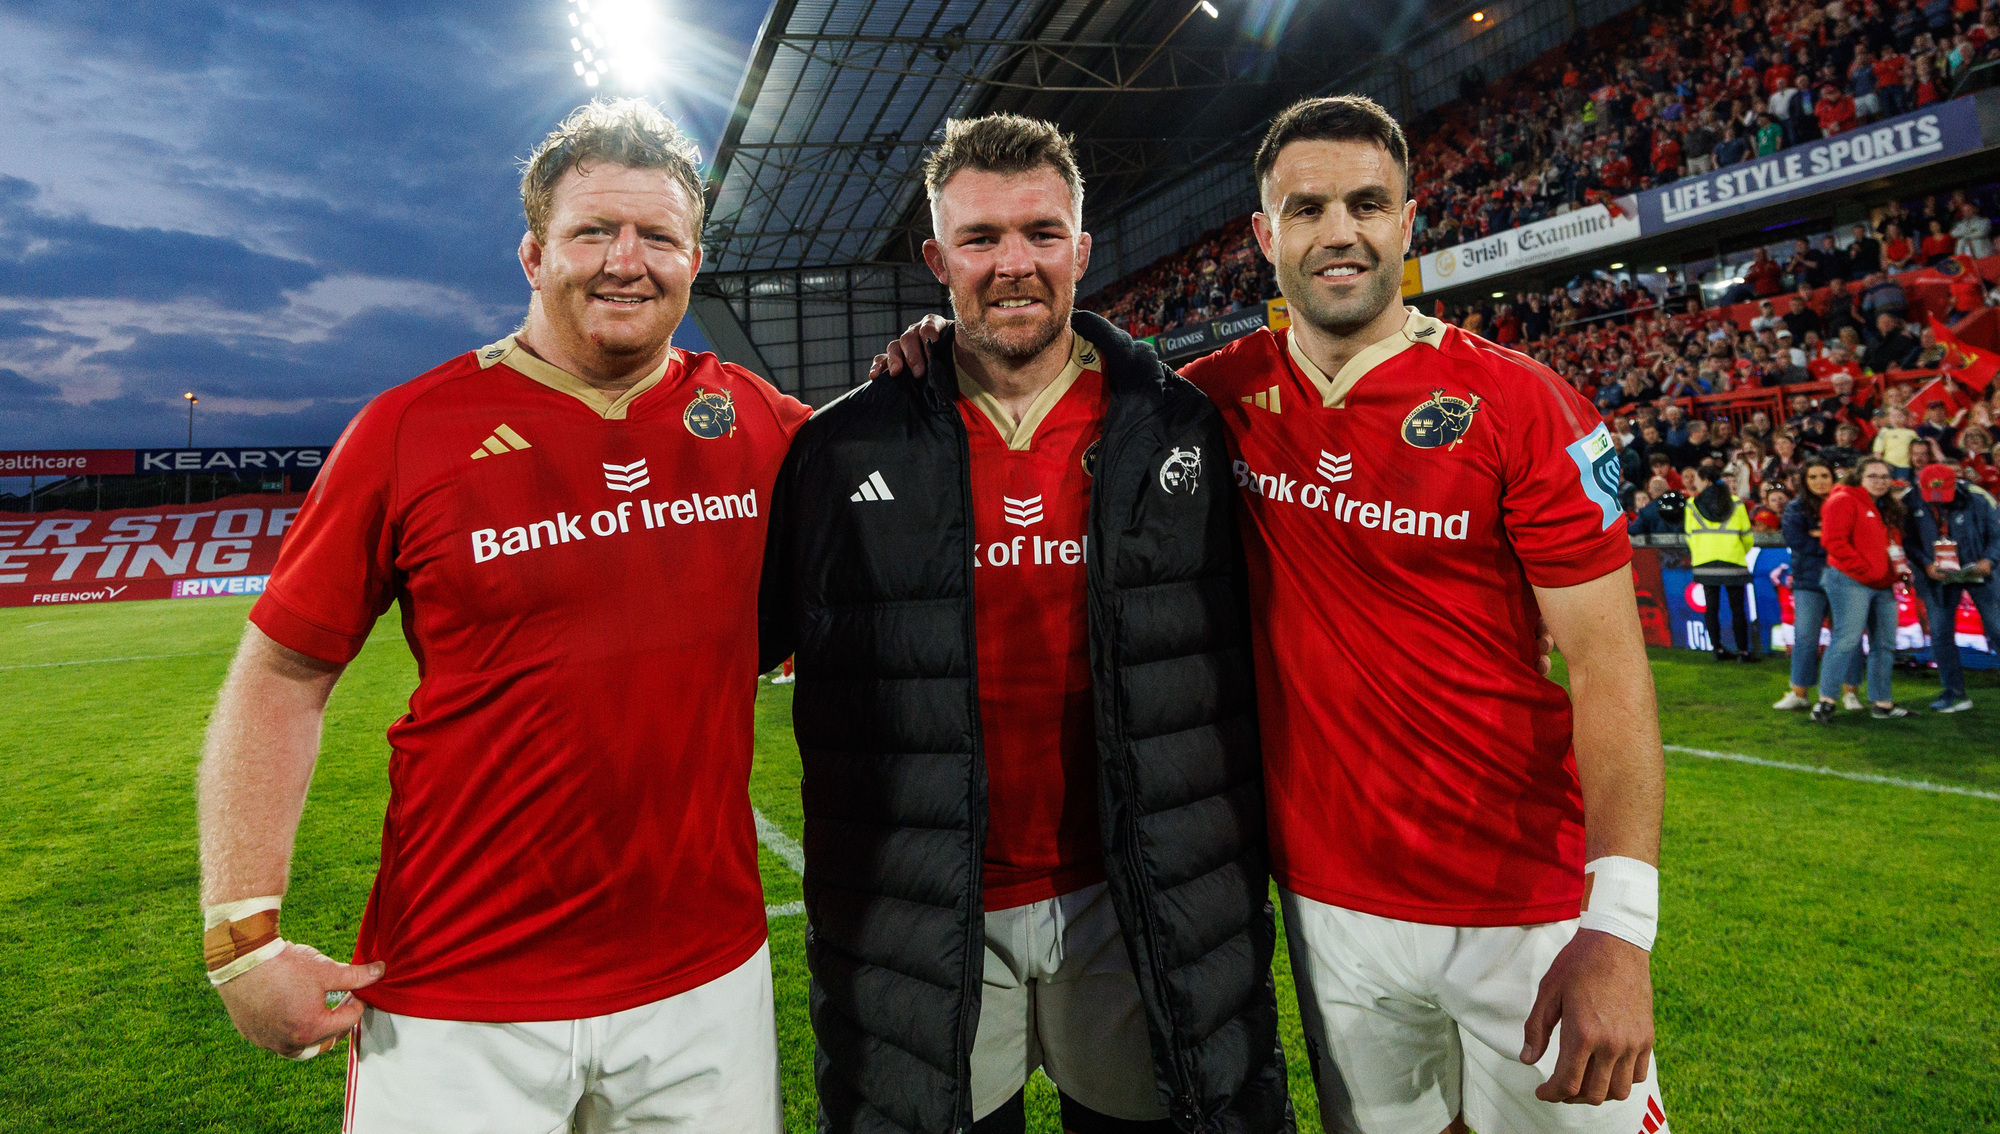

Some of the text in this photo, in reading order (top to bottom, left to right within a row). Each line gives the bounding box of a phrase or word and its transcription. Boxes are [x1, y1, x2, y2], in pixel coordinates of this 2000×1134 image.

[1661, 114, 1942, 216] LIFE STYLE SPORTS
[1462, 213, 1615, 267] Irish Examiner
[1166, 330, 1205, 351] GUINNESS
[1221, 314, 1264, 336] GUINNESS
[143, 450, 322, 471] KEARYS
[1232, 459, 1470, 540] Bank of Ireland
[471, 488, 758, 564] Bank of Ireland
[0, 540, 252, 584] ETING
[987, 535, 1026, 566] of
[33, 591, 105, 603] FREENOW
